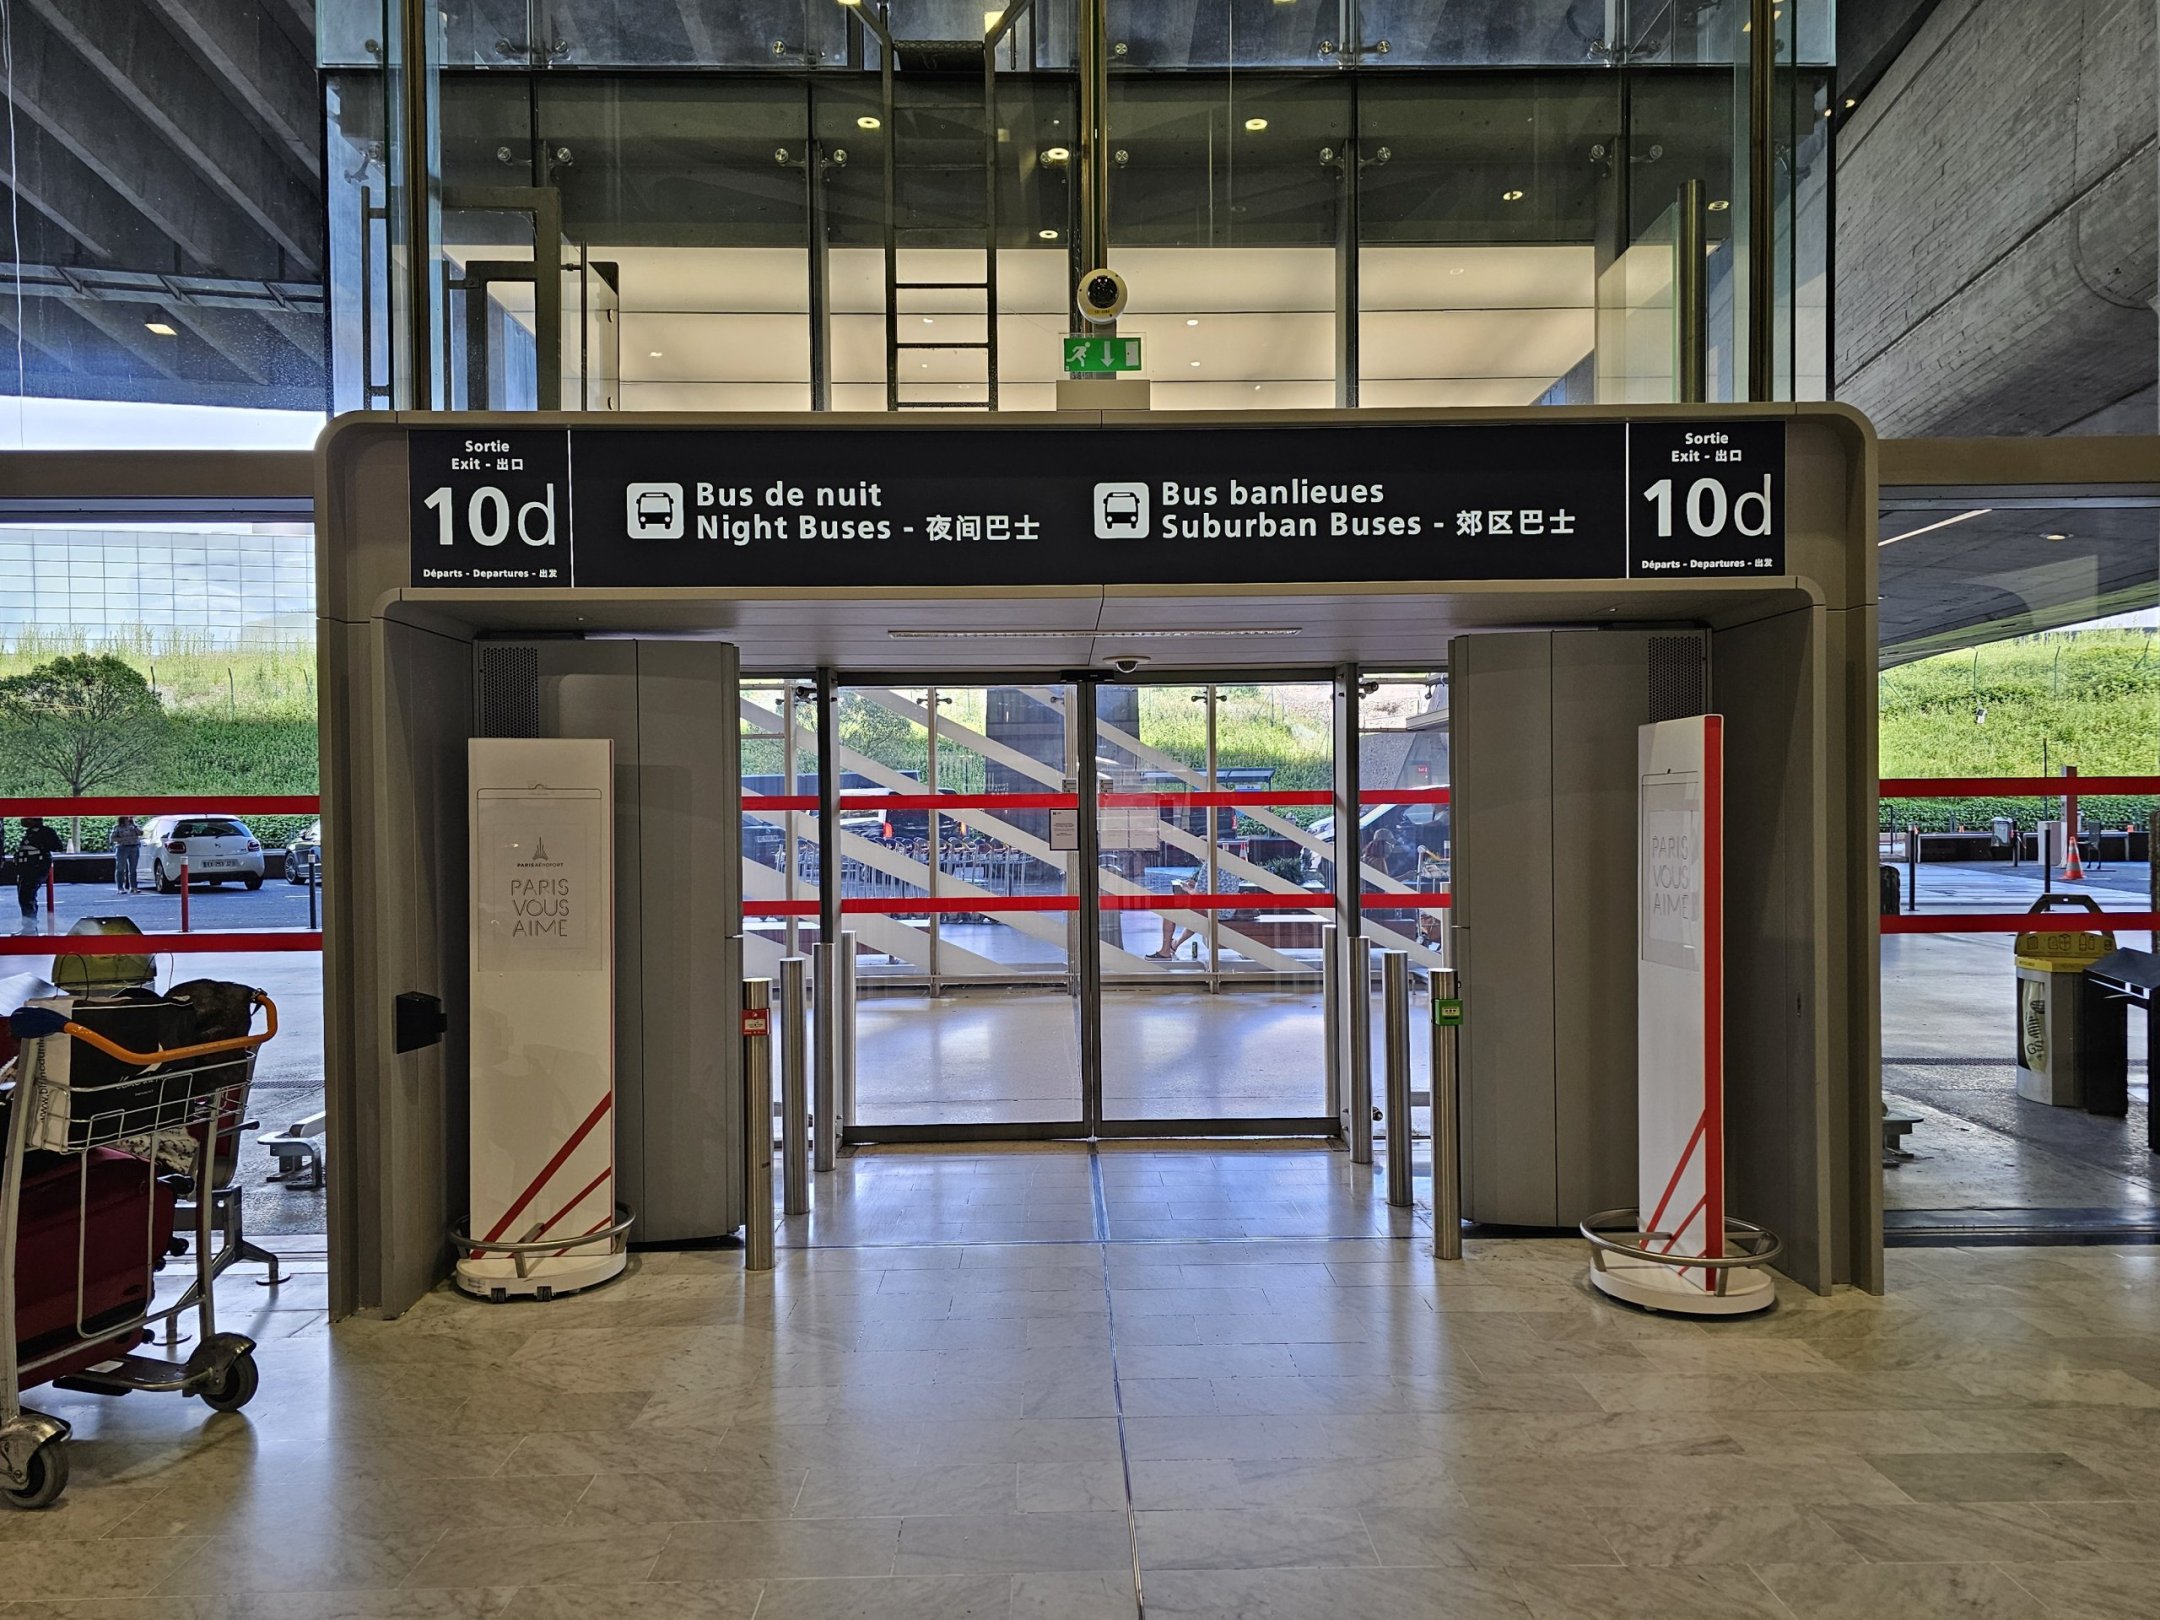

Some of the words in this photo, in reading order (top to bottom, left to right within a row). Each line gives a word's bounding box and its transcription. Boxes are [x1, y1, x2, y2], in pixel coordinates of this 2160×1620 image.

[466, 440, 510, 452] Sortie
[1685, 432, 1729, 445] Sortie
[451, 457, 481, 470] Exit
[496, 458, 524, 471] 出口
[1671, 450, 1700, 462] Exit
[1715, 449, 1742, 462] 出口
[697, 483, 754, 507] Bus
[765, 481, 804, 507] de
[817, 481, 882, 507] nuit
[1162, 482, 1218, 506] Bus
[1231, 479, 1384, 506] banlieues
[423, 483, 556, 546] 10d
[1643, 473, 1772, 537] 10d
[698, 514, 788, 546] Night
[800, 515, 891, 539] Buses
[926, 515, 1040, 541] 夜间巴士
[1162, 512, 1317, 539] Suburban
[1331, 512, 1421, 536] Buses
[1456, 509, 1575, 536] 郊区巴士
[423, 568, 463, 579] Départs
[473, 568, 529, 580] Departures
[539, 568, 557, 578] 出发
[1641, 559, 1681, 571] Départs
[1690, 559, 1745, 570] Departures
[1754, 558, 1773, 568] 出发
[1652, 835, 1688, 860] PARIS
[511, 878, 569, 896] PARIS
[1652, 864, 1689, 889] VOUS
[513, 899, 570, 917] VOUS
[1652, 892, 1689, 919] AIME
[512, 919, 568, 937] AIME
